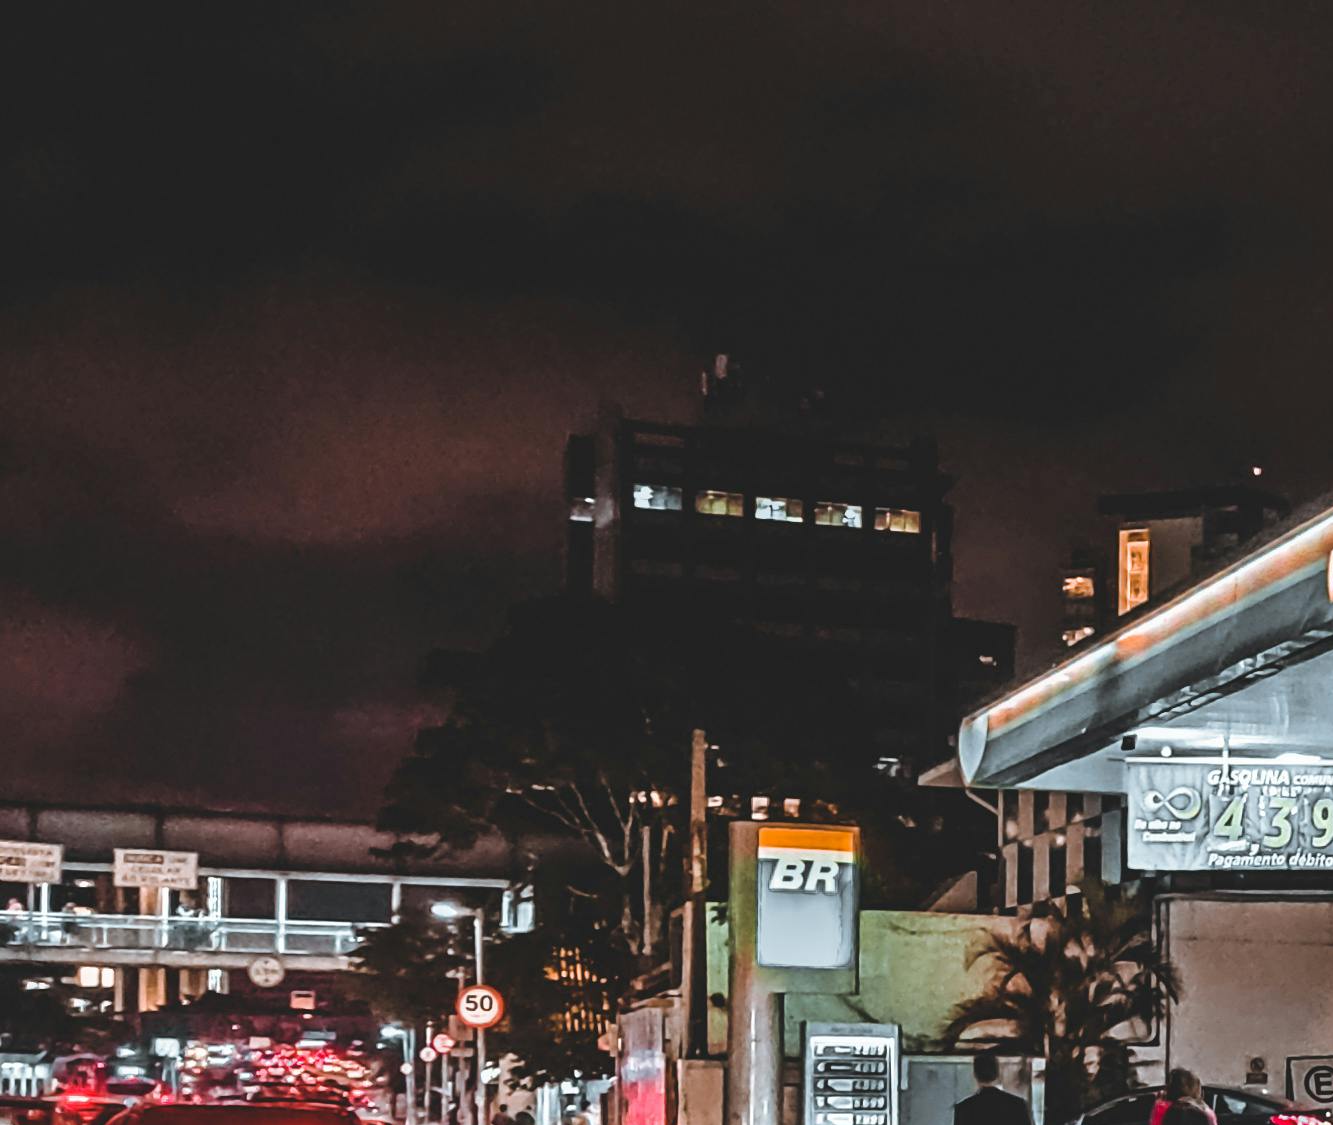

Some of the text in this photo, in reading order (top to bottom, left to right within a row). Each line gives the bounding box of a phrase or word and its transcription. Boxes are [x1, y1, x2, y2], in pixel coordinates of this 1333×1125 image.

[1207, 770, 1290, 787] GASOLINA
[1208, 854, 1286, 869] Pagamento
[769, 858, 840, 893] BR
[465, 994, 493, 1012] 50
[1314, 1072, 1333, 1096] E
